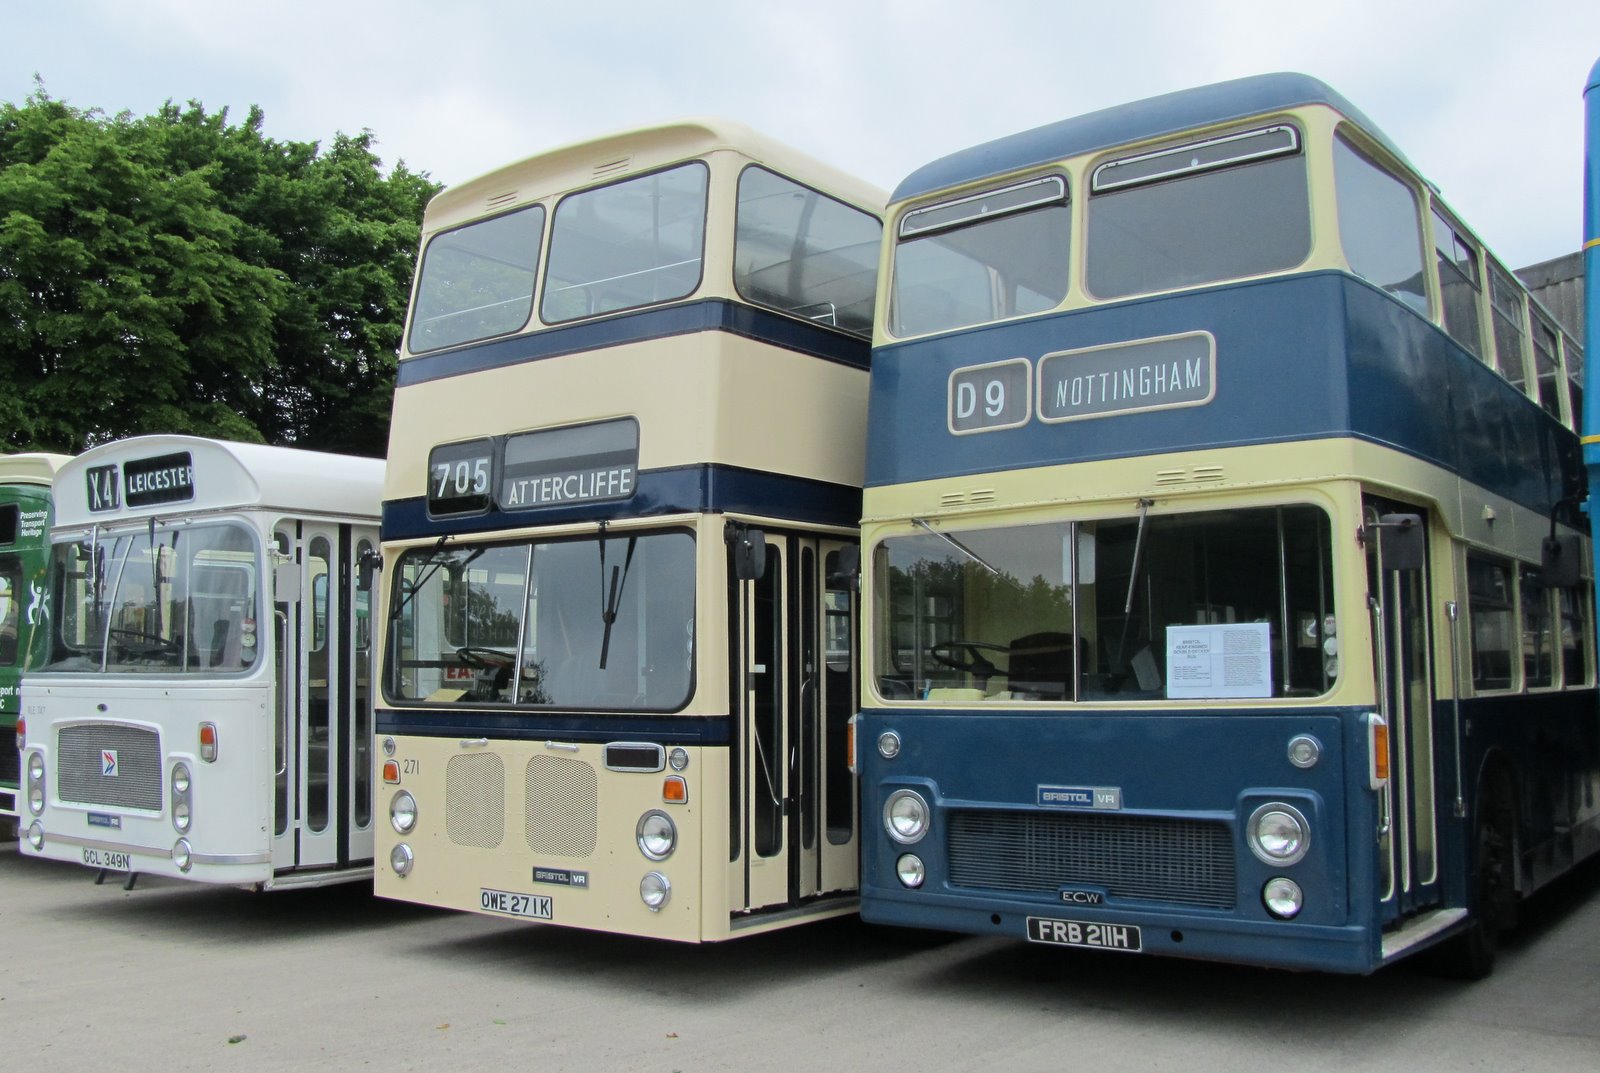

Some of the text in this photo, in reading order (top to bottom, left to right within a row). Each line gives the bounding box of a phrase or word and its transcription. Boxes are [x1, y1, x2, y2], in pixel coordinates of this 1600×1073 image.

[1055, 357, 1201, 408] NOTTINGHAM
[129, 466, 193, 493] LEICESTER
[437, 458, 489, 498] 705
[508, 468, 631, 505] ATTERCLIFFE
[20, 510, 48, 519] Preserving
[21, 519, 45, 528] Transport
[21, 529, 42, 537] Heritage
[1043, 792, 1091, 803] BRISTOL
[83, 849, 130, 868] GCL 349N
[535, 870, 569, 882] BRISTOL
[481, 891, 550, 916] OWE 271K
[1062, 891, 1099, 903] ECW
[1038, 920, 1128, 948] FRB 211H
